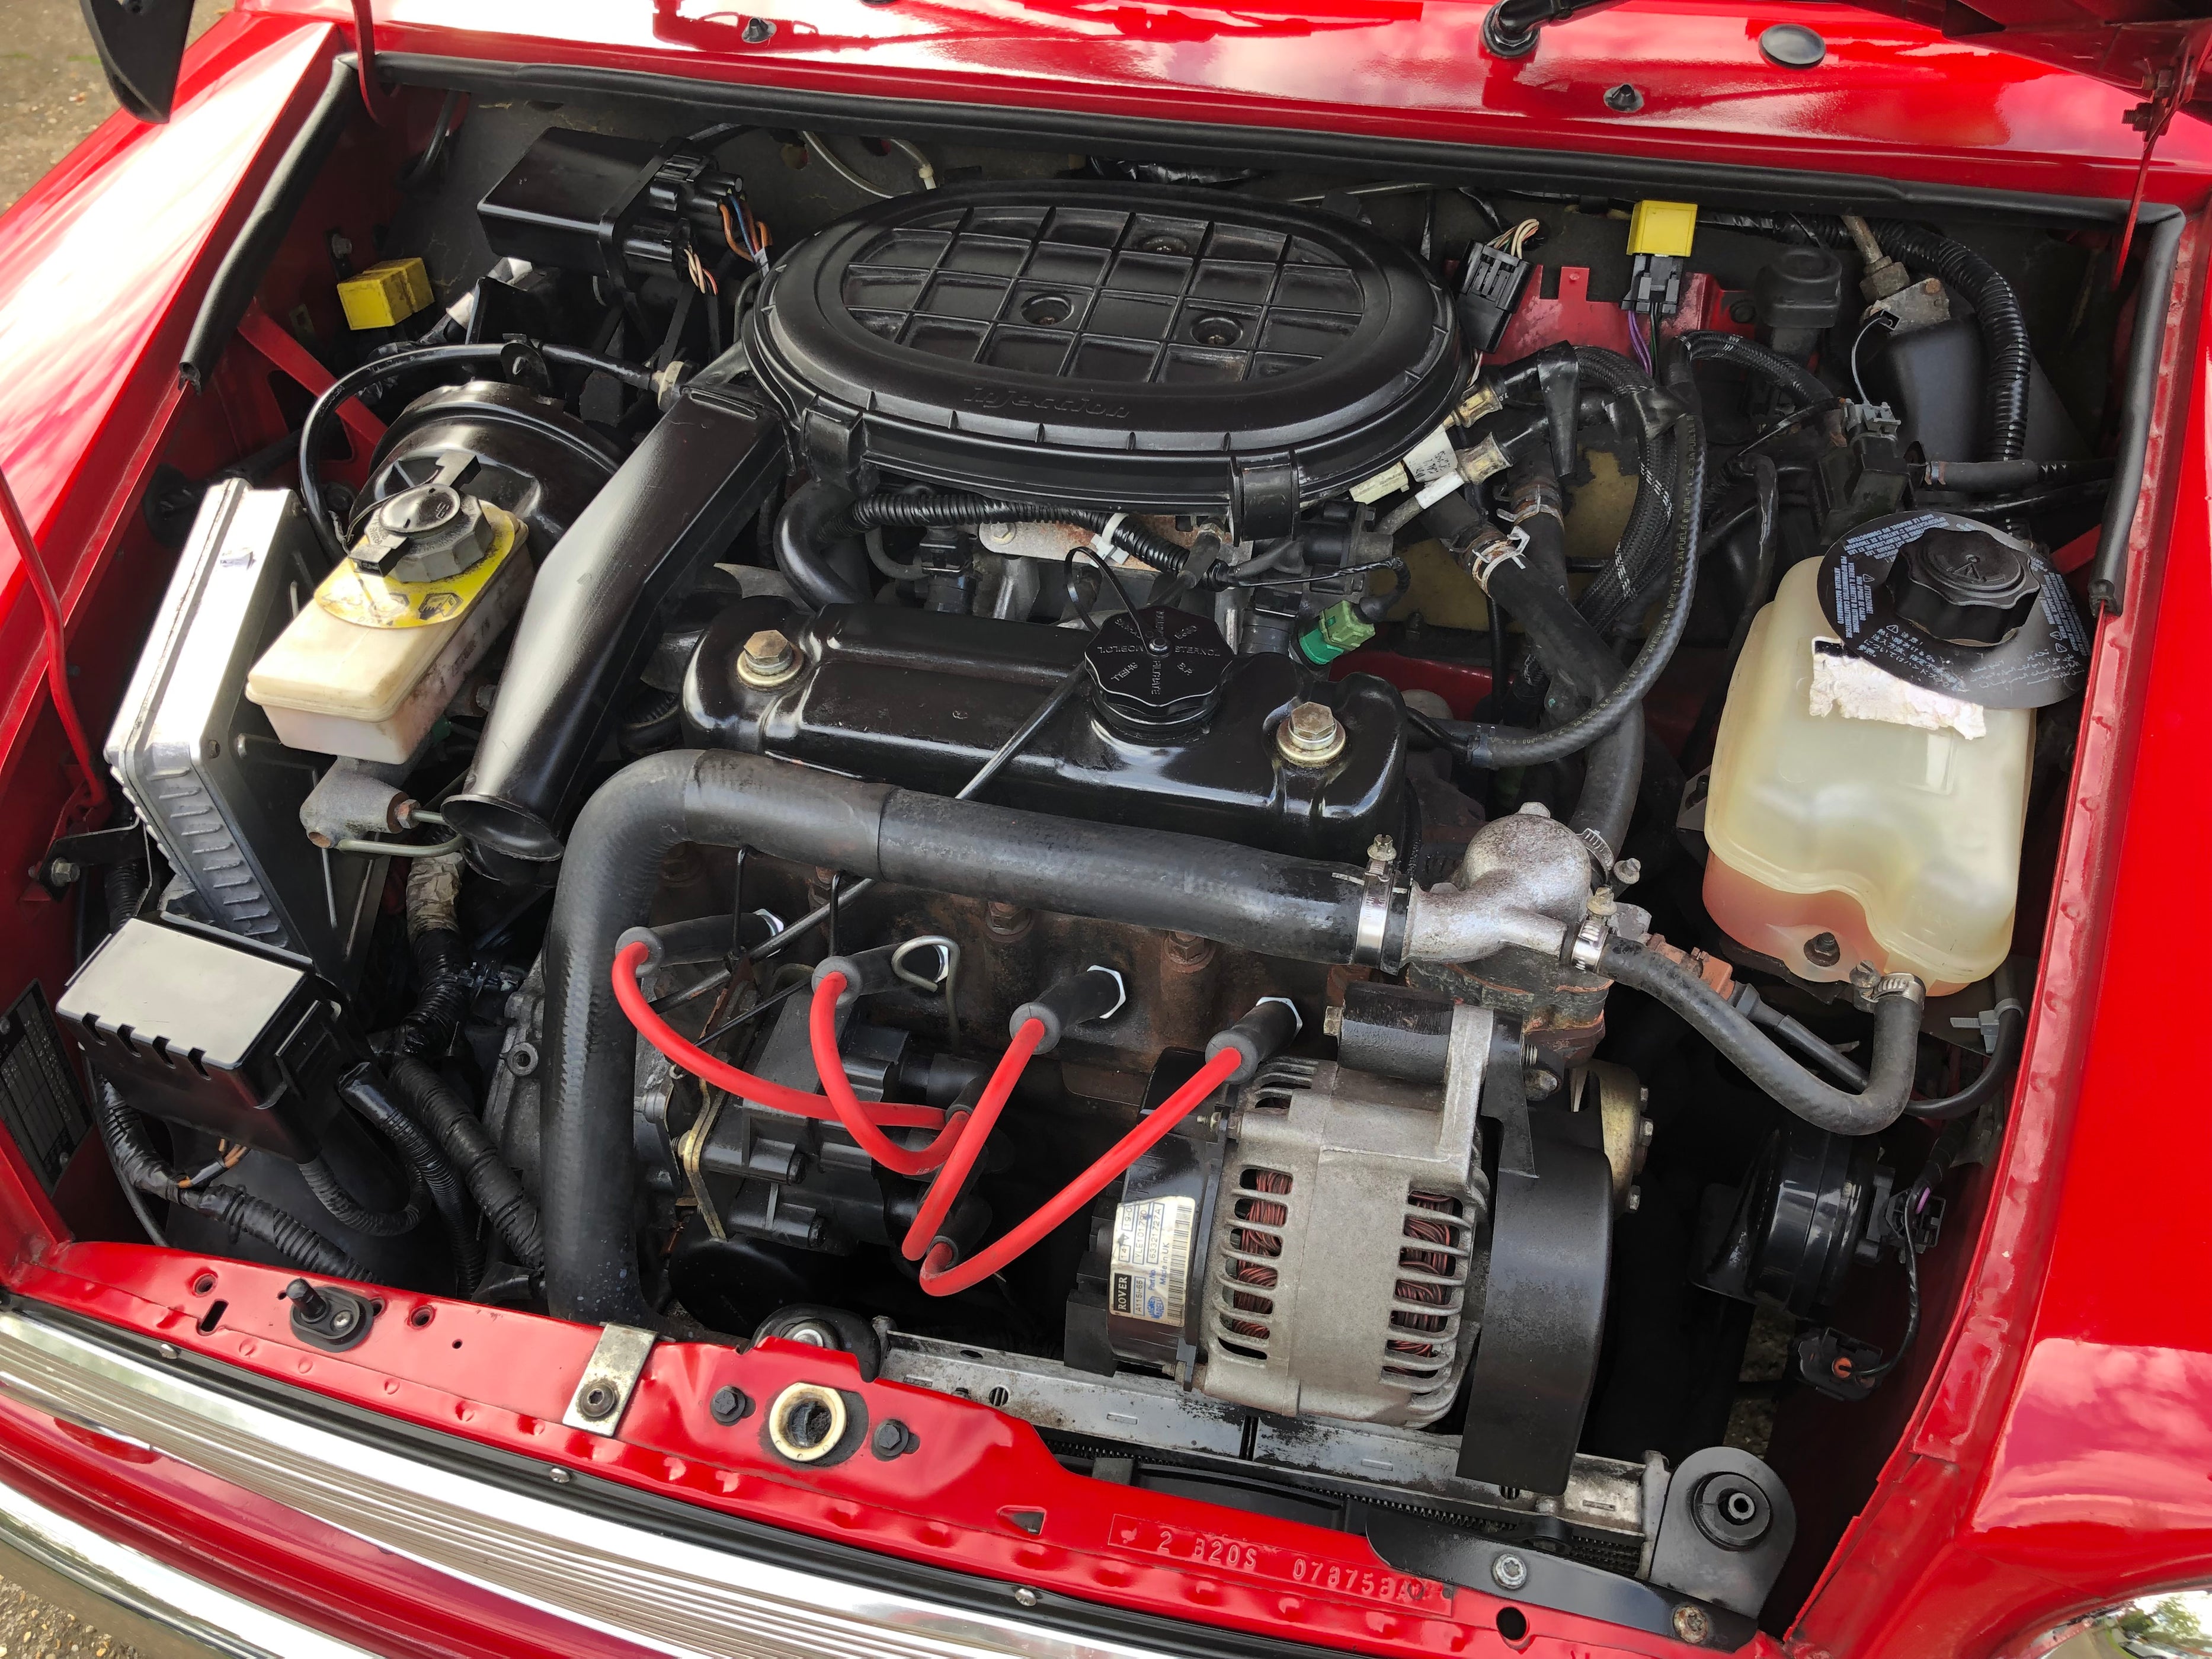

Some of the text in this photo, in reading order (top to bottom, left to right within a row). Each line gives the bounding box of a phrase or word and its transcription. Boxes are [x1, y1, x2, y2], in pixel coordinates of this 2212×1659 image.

[1163, 1242, 1170, 1254] UK
[1161, 1264, 1169, 1285] Made
[1118, 1277, 1128, 1310] ROVER
[1157, 1530, 1172, 1551] 2
